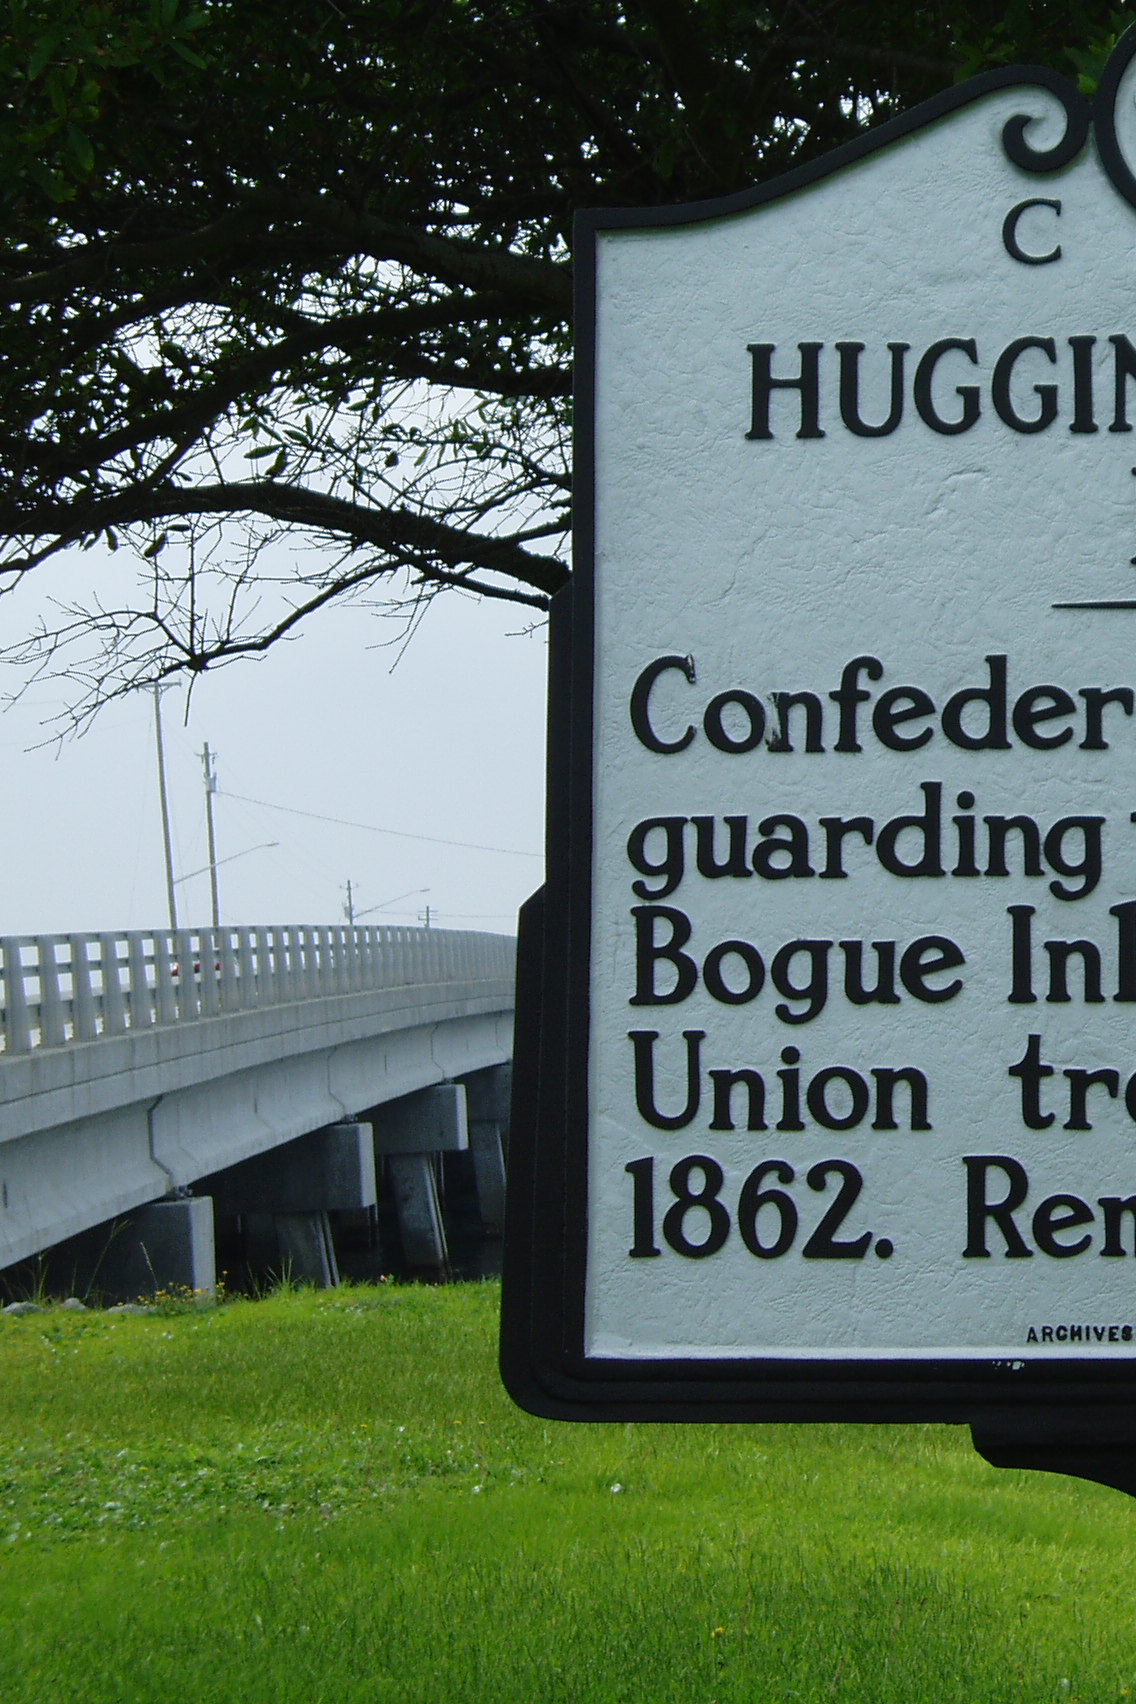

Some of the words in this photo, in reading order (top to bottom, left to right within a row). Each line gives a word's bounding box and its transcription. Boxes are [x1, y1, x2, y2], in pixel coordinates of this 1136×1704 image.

[1001, 197, 1063, 268] C
[626, 779, 1107, 904] guarding
[628, 904, 967, 1028] Bogue
[626, 1029, 934, 1134] Union
[624, 1154, 895, 1262] 1862.
[1025, 1323, 1134, 1345] ARCHIVES
